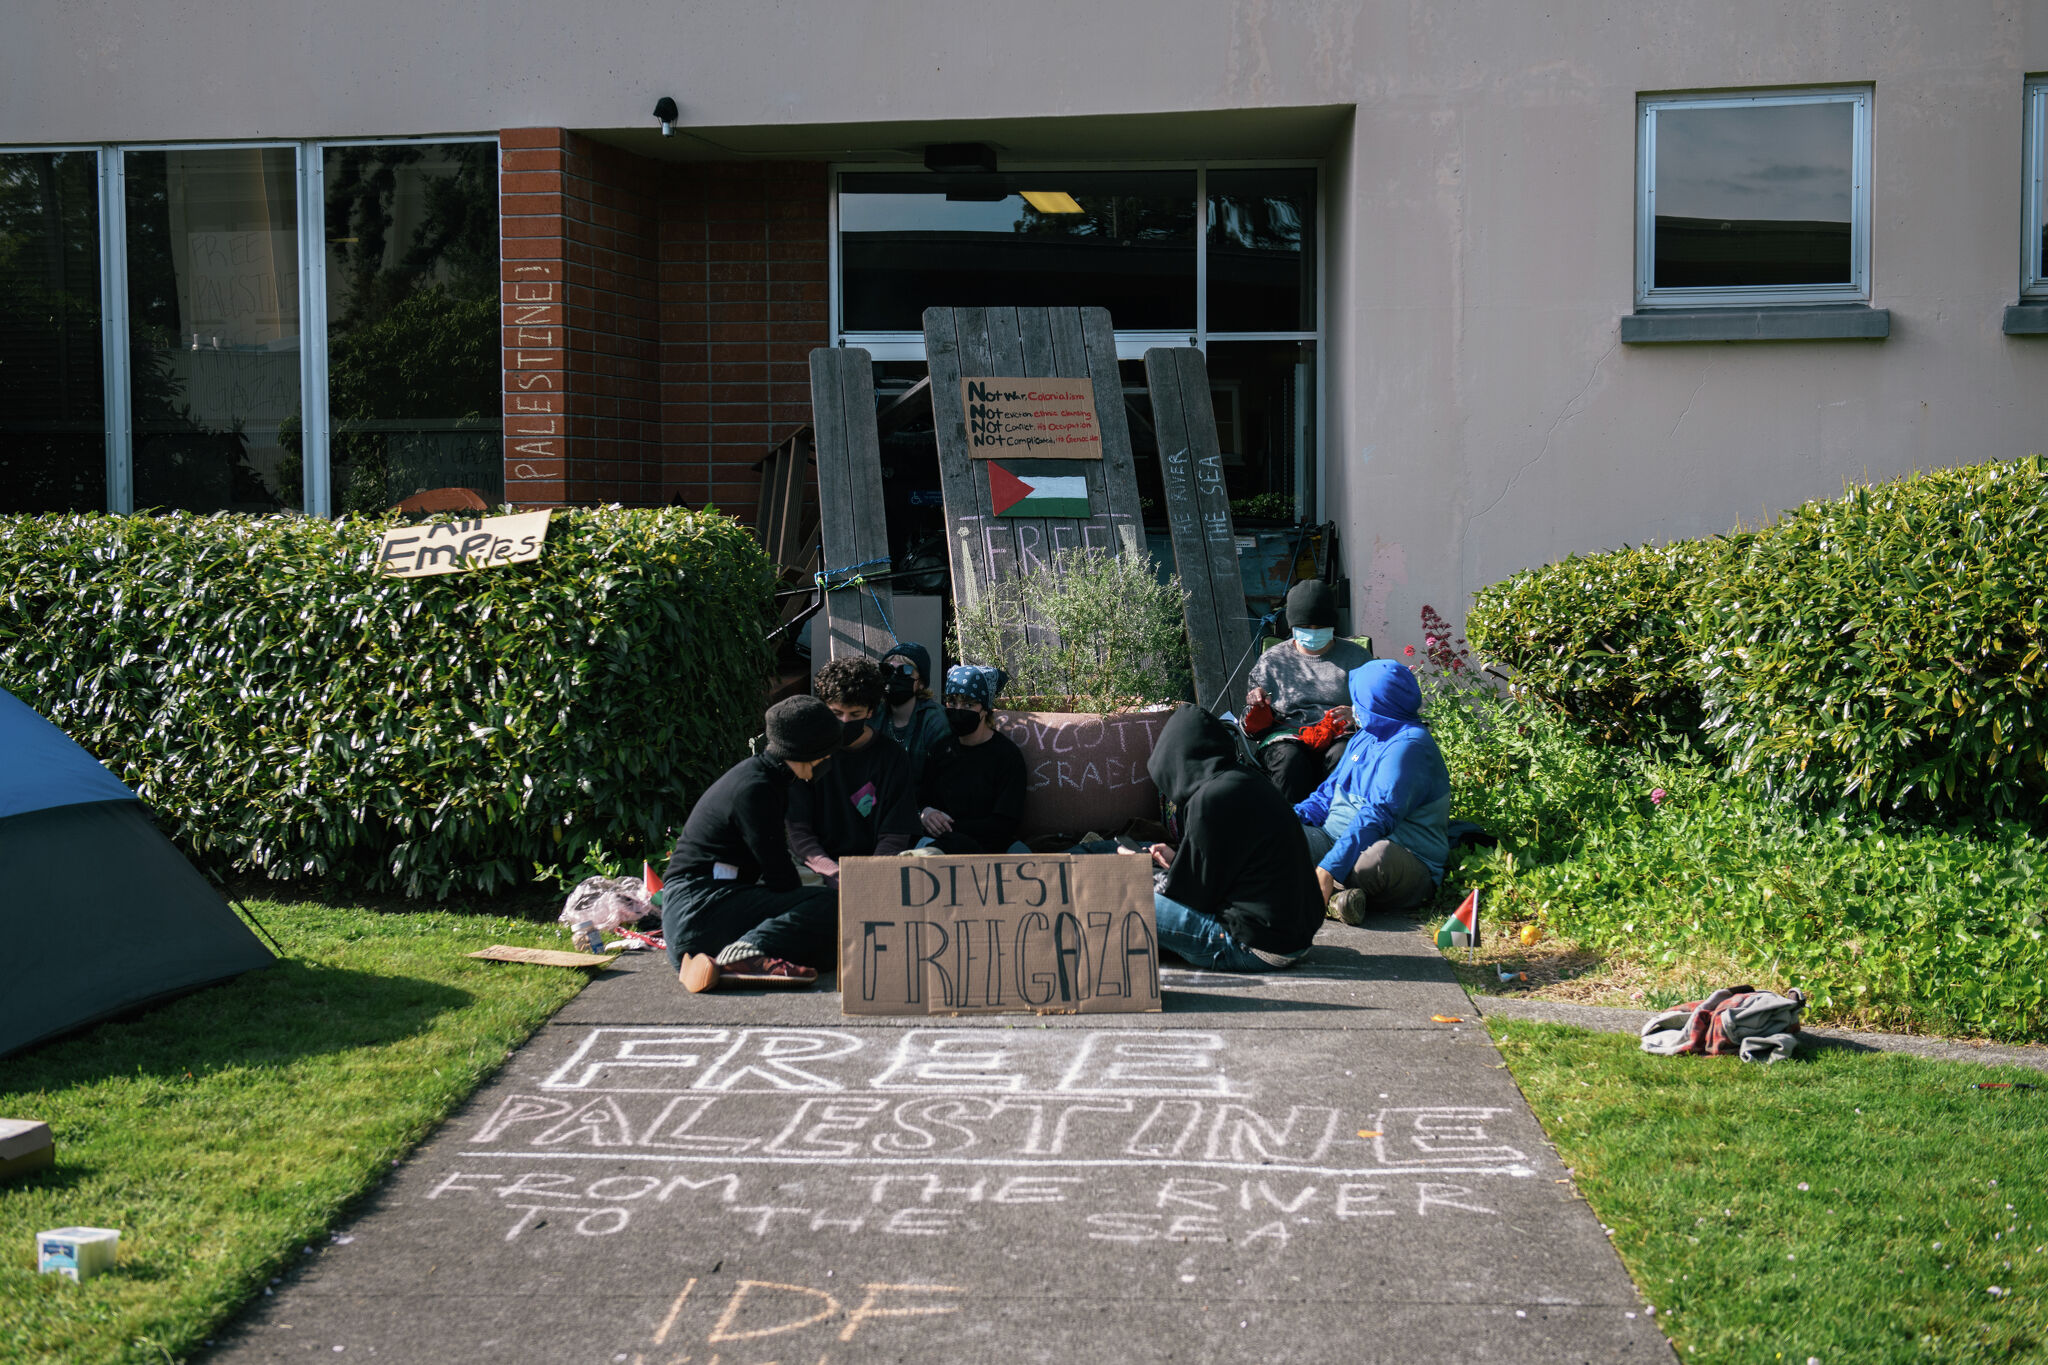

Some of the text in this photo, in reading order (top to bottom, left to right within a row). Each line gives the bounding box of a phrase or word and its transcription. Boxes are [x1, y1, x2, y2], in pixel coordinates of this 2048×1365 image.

[514, 266, 559, 479] PALESTINE!
[1199, 455, 1224, 496] SEA
[1204, 510, 1230, 542] THE
[1027, 759, 1151, 792] SRAEL
[901, 859, 1078, 908] DIVEST
[540, 1027, 1240, 1098] FREE
[468, 1093, 1530, 1168] PALESTINE
[426, 1170, 1498, 1217] FROM THE RIVER
[503, 1202, 1293, 1248] TO THE SEA
[650, 1276, 966, 1344] IDF
